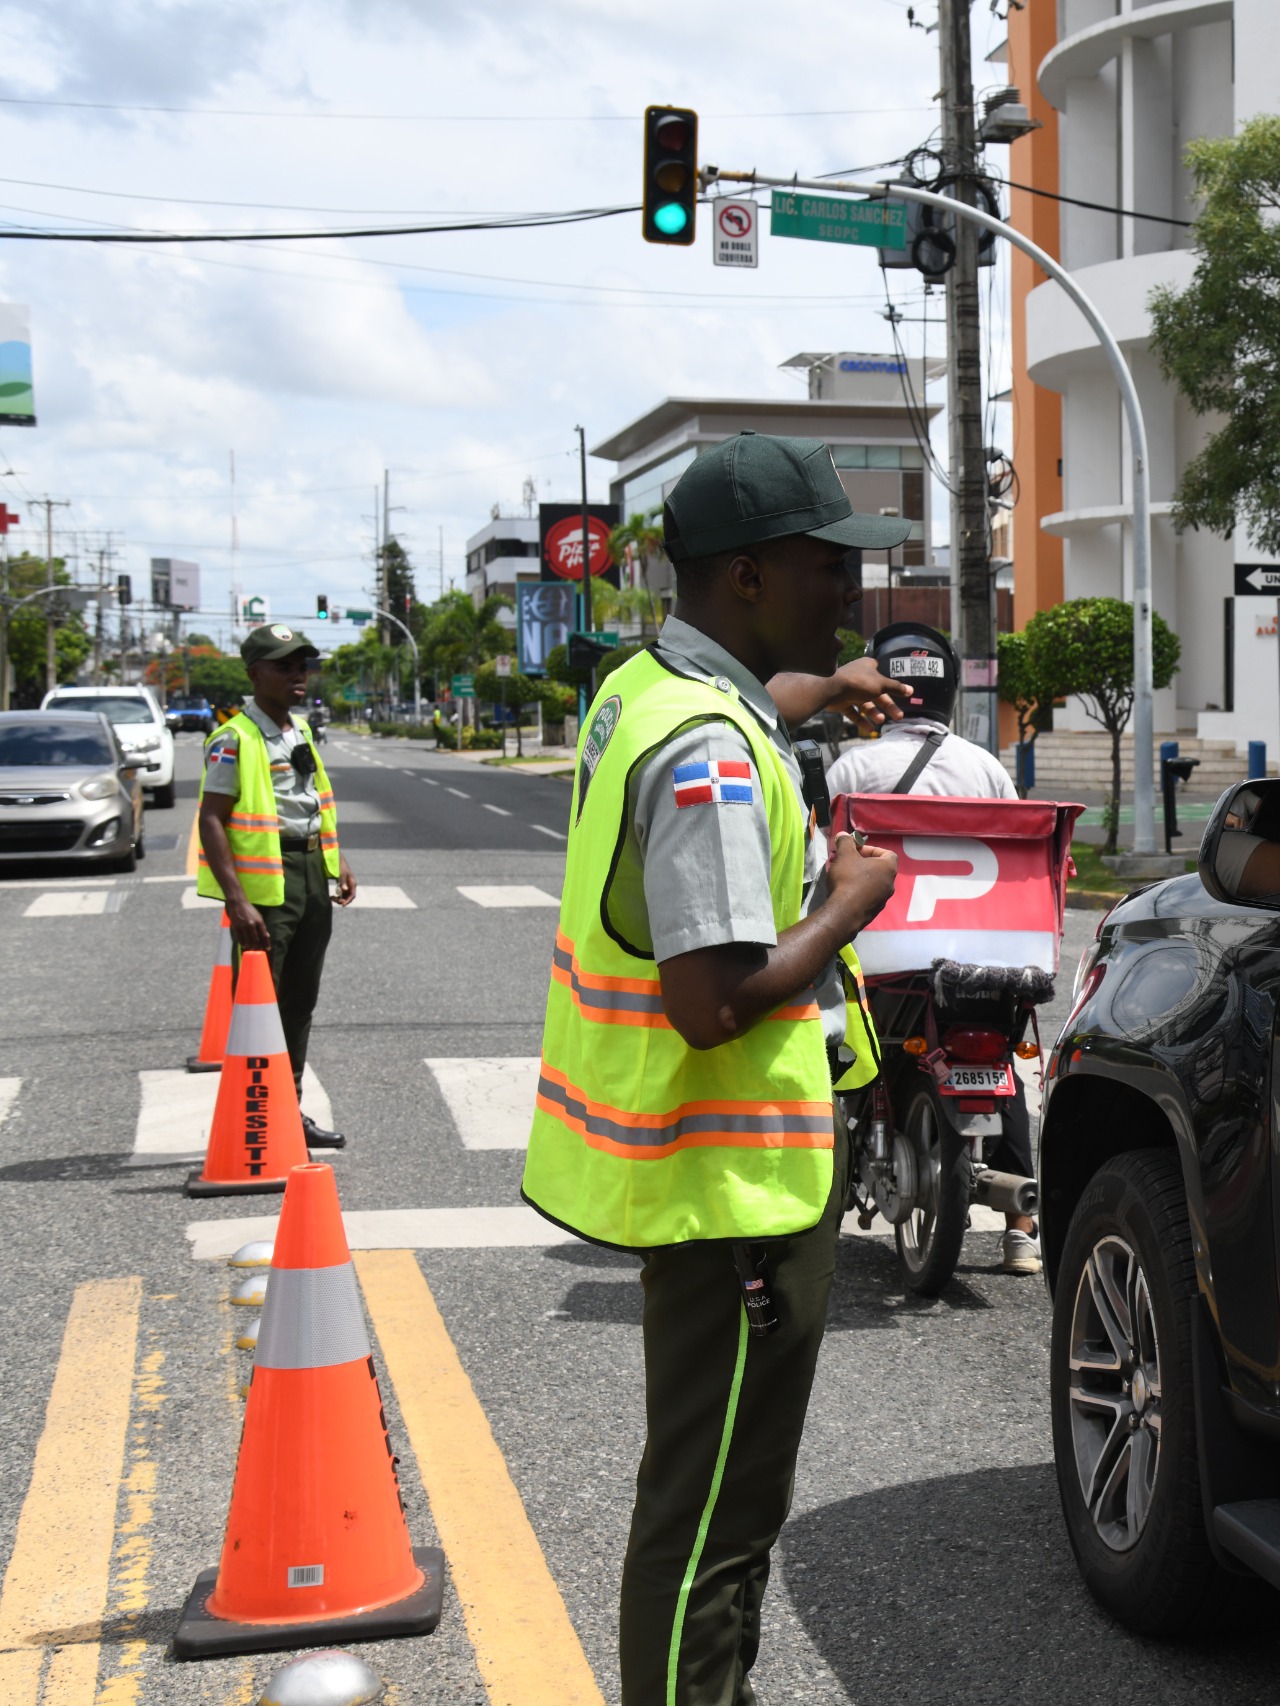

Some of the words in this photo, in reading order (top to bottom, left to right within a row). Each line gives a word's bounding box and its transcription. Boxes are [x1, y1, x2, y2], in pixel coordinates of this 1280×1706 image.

[775, 196, 798, 216] LIC.
[802, 199, 848, 221] CARLOS
[851, 205, 903, 226] SANCHEZ
[819, 224, 860, 241] SEOPC
[559, 541, 600, 563] Piza
[891, 660, 905, 673] AEN
[927, 660, 939, 673] 482
[244, 1057, 269, 1176] DIGESETT
[748, 1299, 770, 1308] POLICE
